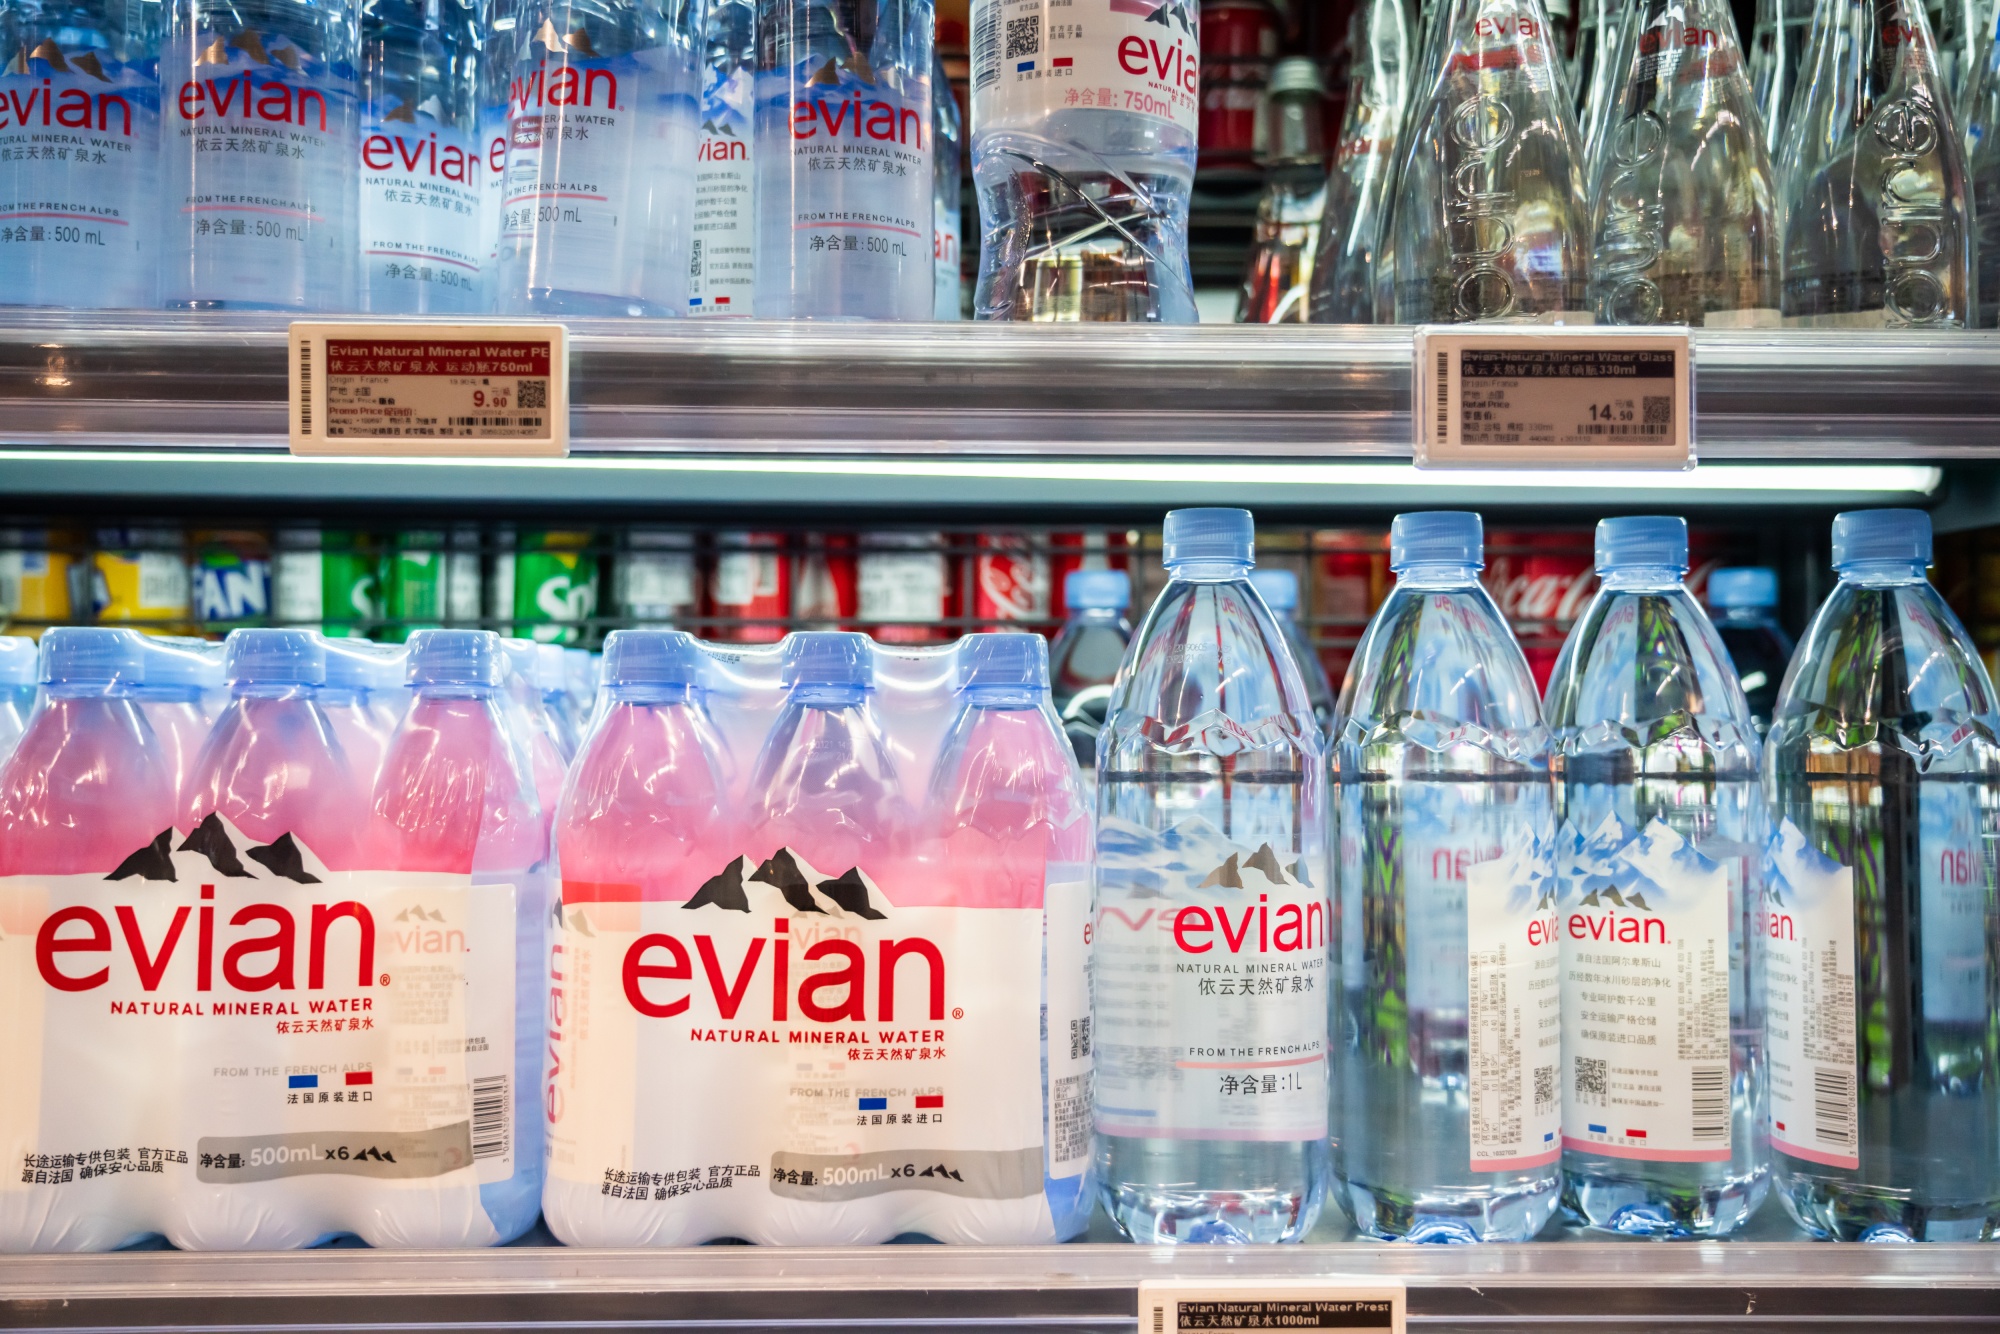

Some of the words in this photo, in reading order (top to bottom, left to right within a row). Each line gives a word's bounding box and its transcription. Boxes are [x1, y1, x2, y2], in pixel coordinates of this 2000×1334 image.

[1118, 35, 1197, 96] evia
[1148, 81, 1179, 97] NATURAL
[179, 70, 327, 132] evian
[1123, 90, 1175, 119] 750mL
[575, 114, 615, 127] WATER
[788, 91, 921, 150] evian
[32, 135, 85, 145] MINERAL
[91, 138, 132, 153] WATER
[180, 126, 226, 138] NATURAL
[231, 126, 285, 139] MINERAL
[290, 132, 326, 148] WATER
[2, 146, 107, 164] 依云天然矿泉水
[196, 138, 305, 159] 依云天然矿泉水
[793, 145, 838, 156] NATURAL
[843, 145, 890, 157] MINERAL
[894, 151, 922, 166] WATER
[808, 156, 907, 177] 依云天然矿泉水
[366, 178, 415, 189] NATURAL
[420, 182, 461, 198] MINERAL
[529, 183, 567, 192] FRENCH
[571, 183, 598, 192] ALPS
[40, 203, 86, 212] FRENCH
[90, 206, 119, 217] ALPS
[186, 195, 212, 204] FROM
[216, 195, 236, 203] THE
[240, 196, 287, 207] FRENCH
[290, 201, 316, 213] ALPS
[385, 189, 473, 217] 依云天然矿泉水
[563, 207, 582, 223] mL
[798, 213, 826, 222] FROM
[829, 212, 849, 220] THE
[852, 212, 892, 223] FRENCH
[895, 217, 915, 229] ALPS
[85, 230, 106, 246] mL
[286, 226, 304, 242] mL
[373, 241, 403, 249] FROM
[406, 243, 425, 252] THE
[428, 246, 462, 260] FRENCH
[892, 241, 907, 257] mL
[329, 346, 369, 357] Evian
[373, 346, 424, 357] Natural
[428, 346, 480, 357] Mineral
[485, 347, 527, 358] Water
[531, 347, 549, 358] PE
[1463, 352, 1498, 361] Evian
[1550, 352, 1594, 362] Mineral
[1599, 352, 1636, 362] Water
[1639, 353, 1673, 362] Glass
[331, 360, 439, 373] 依云天然矿泉水
[360, 376, 389, 384] France
[473, 390, 508, 408] 9.90
[1463, 401, 1486, 409] Retail
[1488, 401, 1510, 409] Price
[329, 407, 358, 415] Promo
[1589, 404, 1633, 421] 14.50
[1173, 893, 1323, 955] evian
[1527, 911, 1559, 947] evia
[1568, 910, 1666, 944] evian
[35, 884, 375, 992] evian
[1176, 963, 1240, 974] NATURAL
[1246, 962, 1298, 974] MINERAL
[1301, 957, 1324, 971] WATER
[1576, 952, 1661, 968] 源自法国阿尔卑斯山
[621, 917, 946, 1023] evian
[1568, 970, 1672, 988] 历经数年冰川砂层的净化
[1198, 973, 1314, 997] 依云天然矿泉水
[111, 1001, 204, 1016] NATURAL
[213, 1001, 299, 1016] MINERAL
[308, 998, 373, 1014] WATER
[1580, 991, 1657, 1007] 专业呵护数千公里
[276, 1016, 374, 1035] 依云天然矿泉水
[1580, 1010, 1657, 1026] 安全运输严格仓储
[690, 1028, 780, 1044] NATURAL
[789, 1030, 870, 1044] MINERAL
[878, 1029, 945, 1044] WATER
[1581, 1029, 1657, 1046] 确保原装进口品质
[847, 1046, 946, 1062] 依云天然矿泉水
[1189, 1047, 1226, 1057] FROM
[1230, 1047, 1254, 1057] THE
[1258, 1044, 1301, 1056] FRENCH
[1303, 1040, 1320, 1053] ALPS
[213, 1067, 249, 1077] FROM
[254, 1066, 280, 1077] THE
[284, 1064, 338, 1076] FRENCH
[342, 1062, 373, 1073] ALPS
[287, 1090, 373, 1105] 法国原装进口
[789, 1087, 824, 1098] FROM
[828, 1087, 850, 1098] THE
[855, 1087, 907, 1098] FRENCH
[911, 1086, 944, 1097] ALPS
[856, 1113, 943, 1127] 法国原装进口
[1848, 1111, 1857, 1145] 068320
[24, 1147, 132, 1170] 长途运输专供包装
[138, 1147, 190, 1165] 官方正品
[249, 1145, 325, 1167] 500mL
[325, 1145, 350, 1161] x6
[21, 1168, 74, 1185] 源自法国
[79, 1158, 165, 1181] 确保安心品质
[604, 1166, 701, 1187] 长途运输专供包装
[708, 1164, 761, 1179] 官方正品
[822, 1162, 889, 1187] 500mL
[891, 1163, 915, 1178] x6
[601, 1181, 648, 1201] 源自法国
[654, 1175, 733, 1201] 确保安心品质
[1178, 1303, 1214, 1313] Evian
[1217, 1303, 1262, 1313] Natural
[1266, 1302, 1311, 1313] Mineral
[1315, 1302, 1352, 1312] Water
[1355, 1301, 1389, 1312] Prest
[1179, 1314, 1320, 1327] 依云天然矿泉水1000ml
